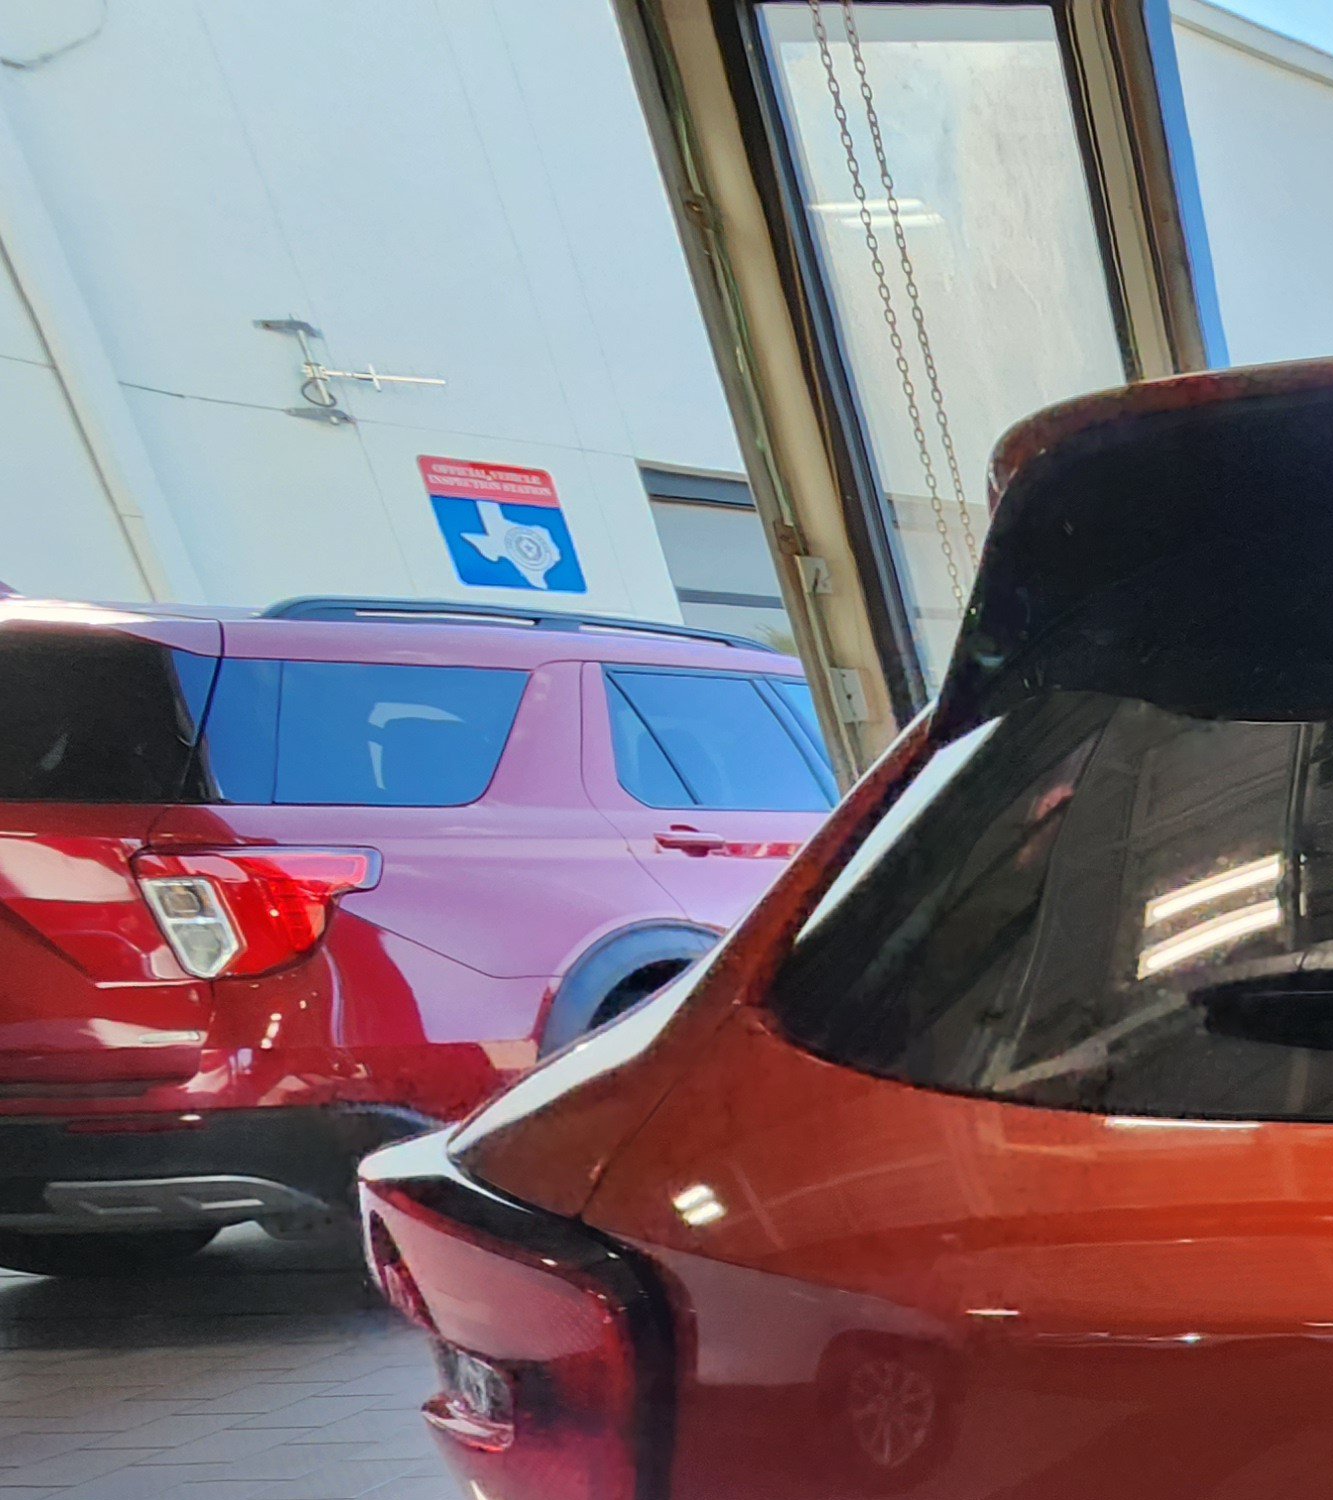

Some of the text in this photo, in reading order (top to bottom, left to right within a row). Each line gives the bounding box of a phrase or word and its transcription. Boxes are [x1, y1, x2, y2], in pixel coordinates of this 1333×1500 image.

[431, 464, 542, 485] OFFICIAL VEHICLE
[502, 482, 552, 496] STATION
